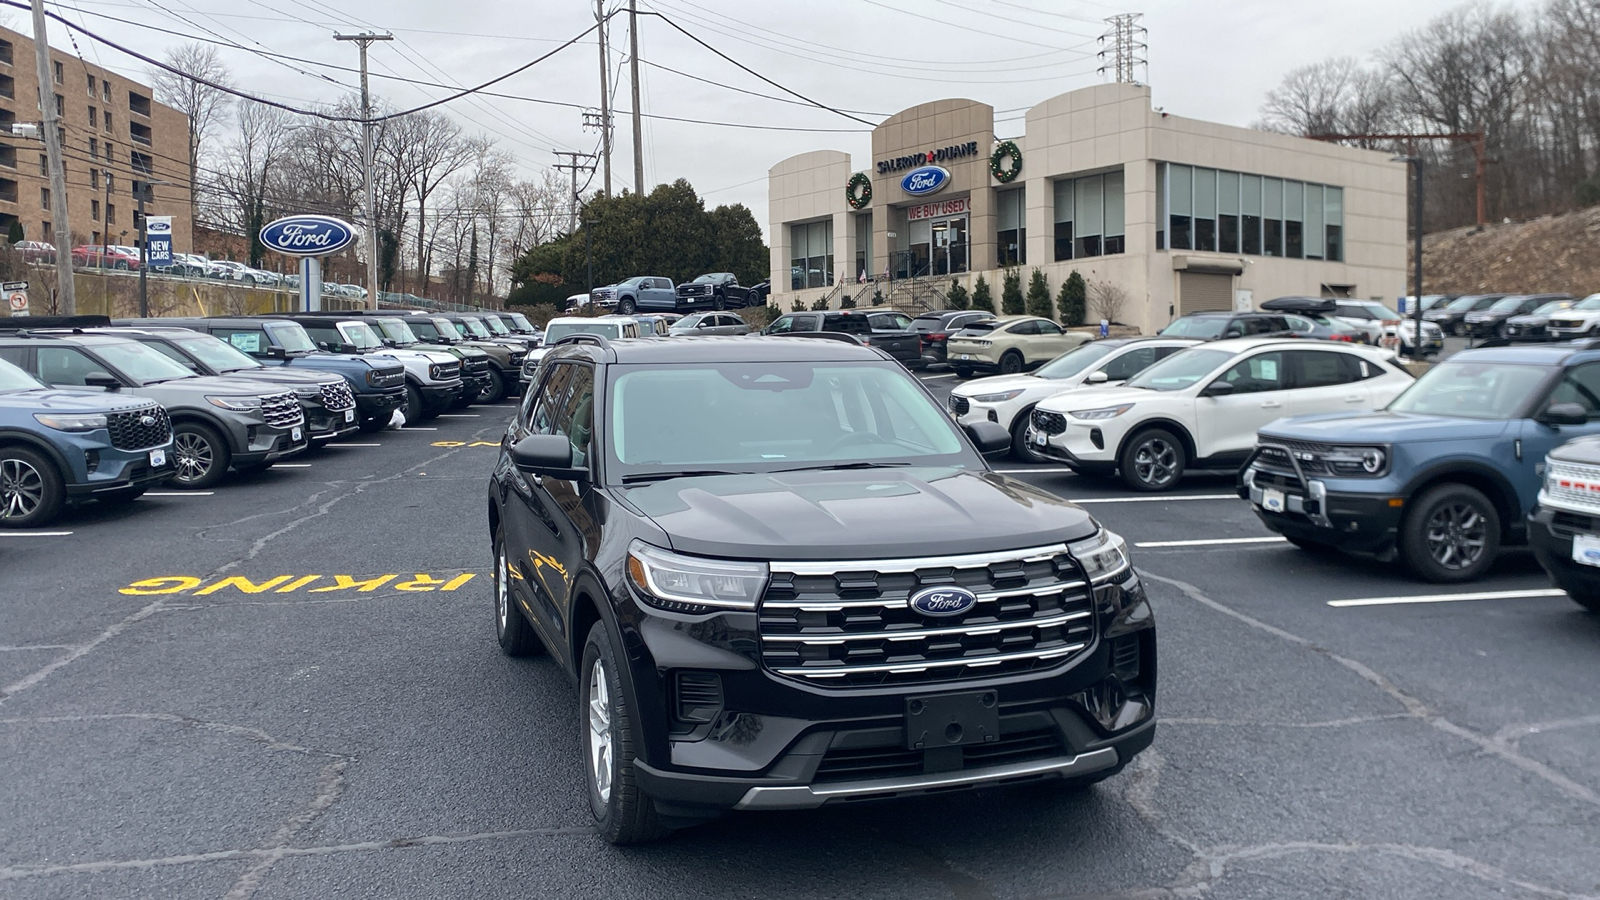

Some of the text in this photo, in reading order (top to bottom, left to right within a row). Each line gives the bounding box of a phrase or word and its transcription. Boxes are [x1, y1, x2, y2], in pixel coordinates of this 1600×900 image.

[876, 141, 978, 174] SALERNO DUANE
[909, 172, 936, 190] Ford
[908, 206, 922, 219] WE
[923, 203, 940, 217] BUY
[942, 199, 965, 214] USED
[278, 224, 332, 247] Ford
[151, 240, 169, 251] NEW
[151, 251, 170, 260] CARS
[118, 572, 495, 597] RKING
[927, 593, 963, 610] Ford
